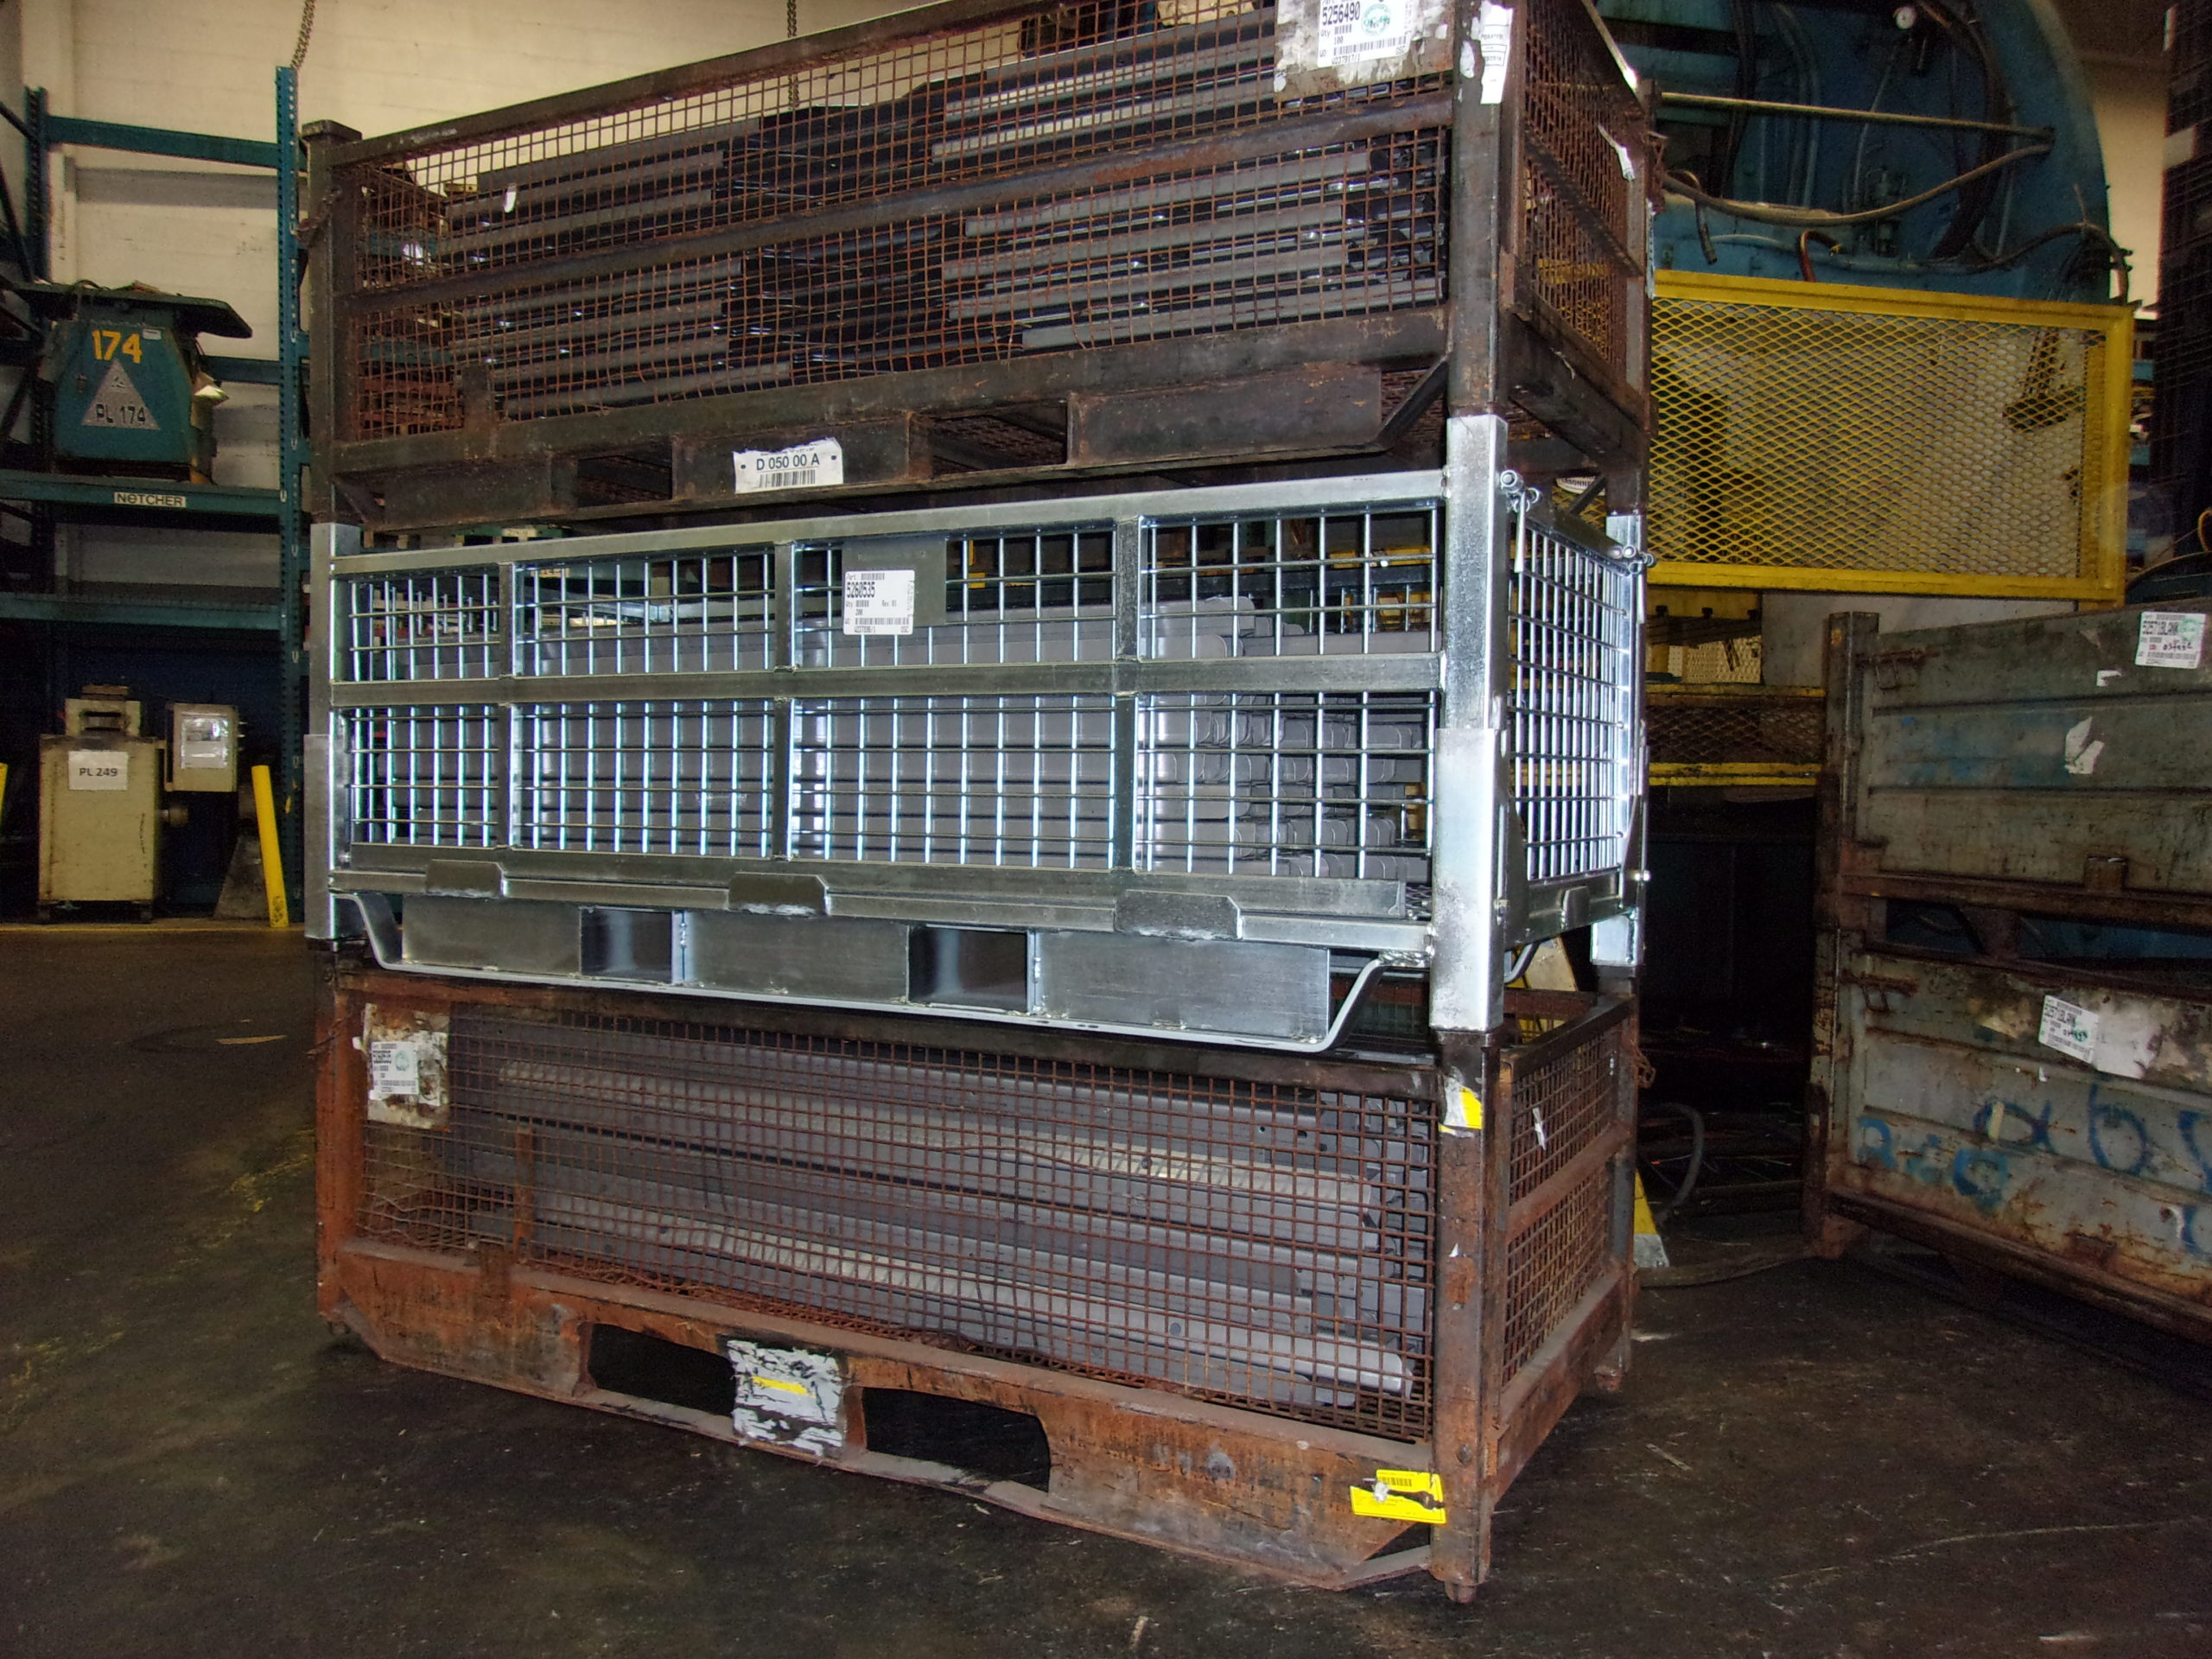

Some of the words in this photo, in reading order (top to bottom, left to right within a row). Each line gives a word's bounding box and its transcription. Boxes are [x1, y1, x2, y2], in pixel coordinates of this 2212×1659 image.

[1323, 2, 1361, 25] 5256490
[1334, 36, 1344, 45] 100
[92, 330, 143, 364] 174
[95, 404, 114, 423] PL
[119, 405, 146, 425] 174
[756, 458, 766, 471] D
[768, 455, 790, 470] 050
[792, 454, 808, 467] 00
[810, 453, 820, 466] A
[847, 581, 875, 598] 5260535
[79, 767, 93, 777] PL
[96, 767, 118, 777] 249
